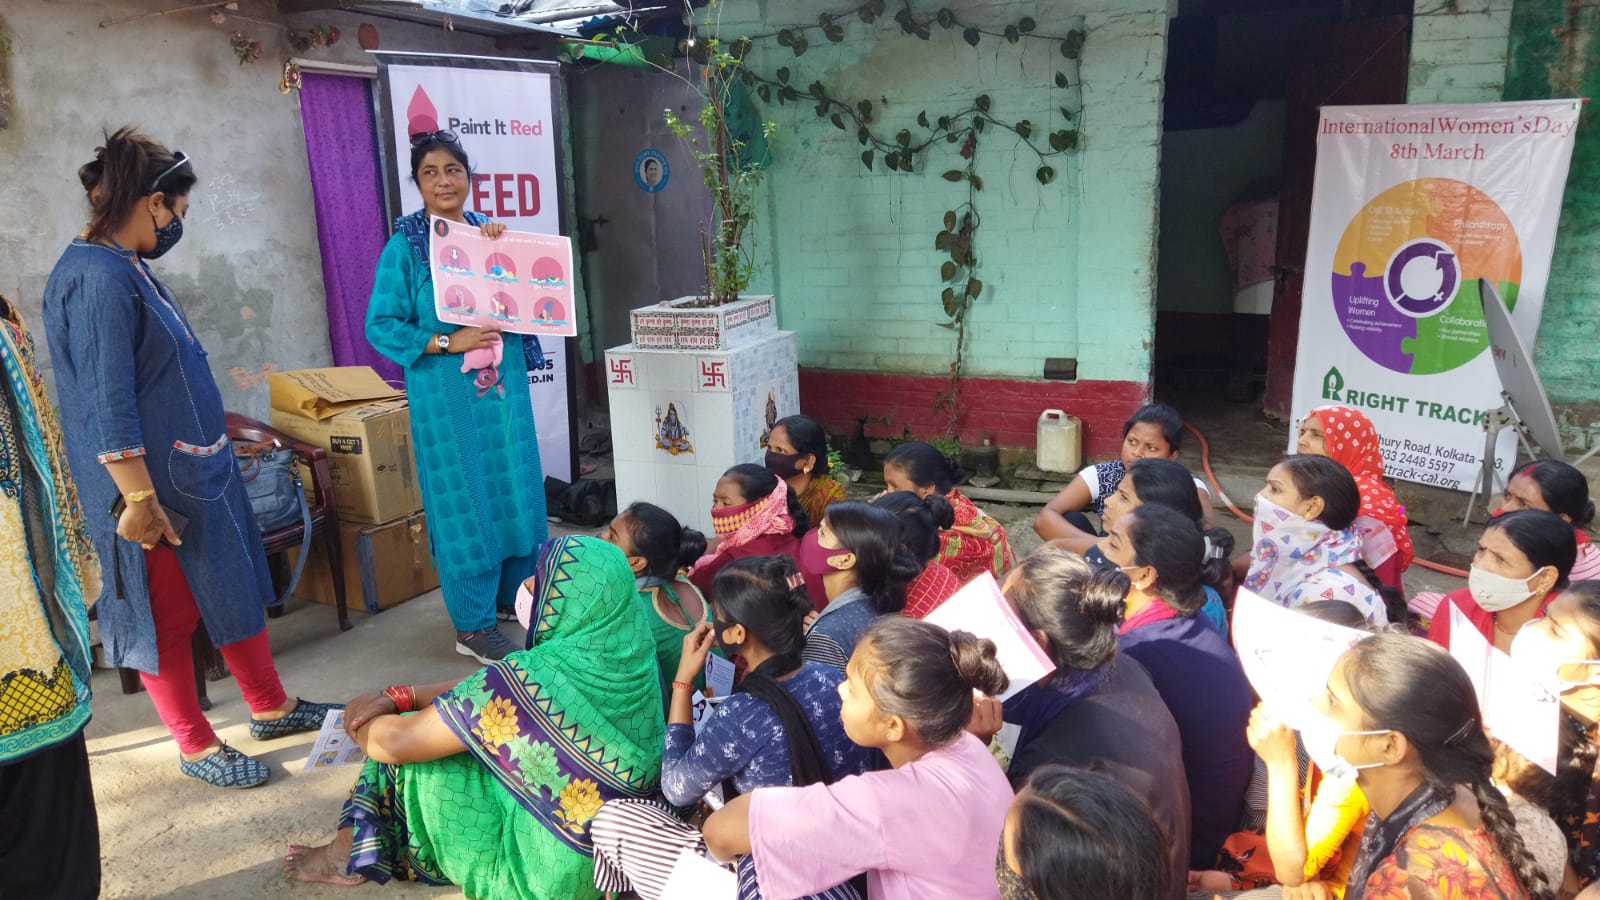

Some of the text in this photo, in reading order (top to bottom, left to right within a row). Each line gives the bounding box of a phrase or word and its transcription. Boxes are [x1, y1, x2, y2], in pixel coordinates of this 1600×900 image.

[448, 117, 542, 136] Paint It Red
[1322, 115, 1576, 138] International Women's Day
[1390, 142, 1485, 160] 8th March
[471, 173, 541, 217] EED
[1454, 219, 1508, 232] Philanthropy
[1349, 295, 1380, 307] Uplifting
[1347, 306, 1376, 317] Women
[1440, 315, 1487, 328] Collaborati
[527, 374, 554, 385] ED.IN
[1346, 389, 1487, 426] RIGHT TRACK
[1378, 434, 1402, 449] hury
[1404, 438, 1432, 456] Road,
[1436, 447, 1475, 464] Kolkata
[1399, 452, 1426, 467] 2448
[1428, 457, 1455, 474] 5597
[1383, 463, 1461, 490] ttrack-cal.org
